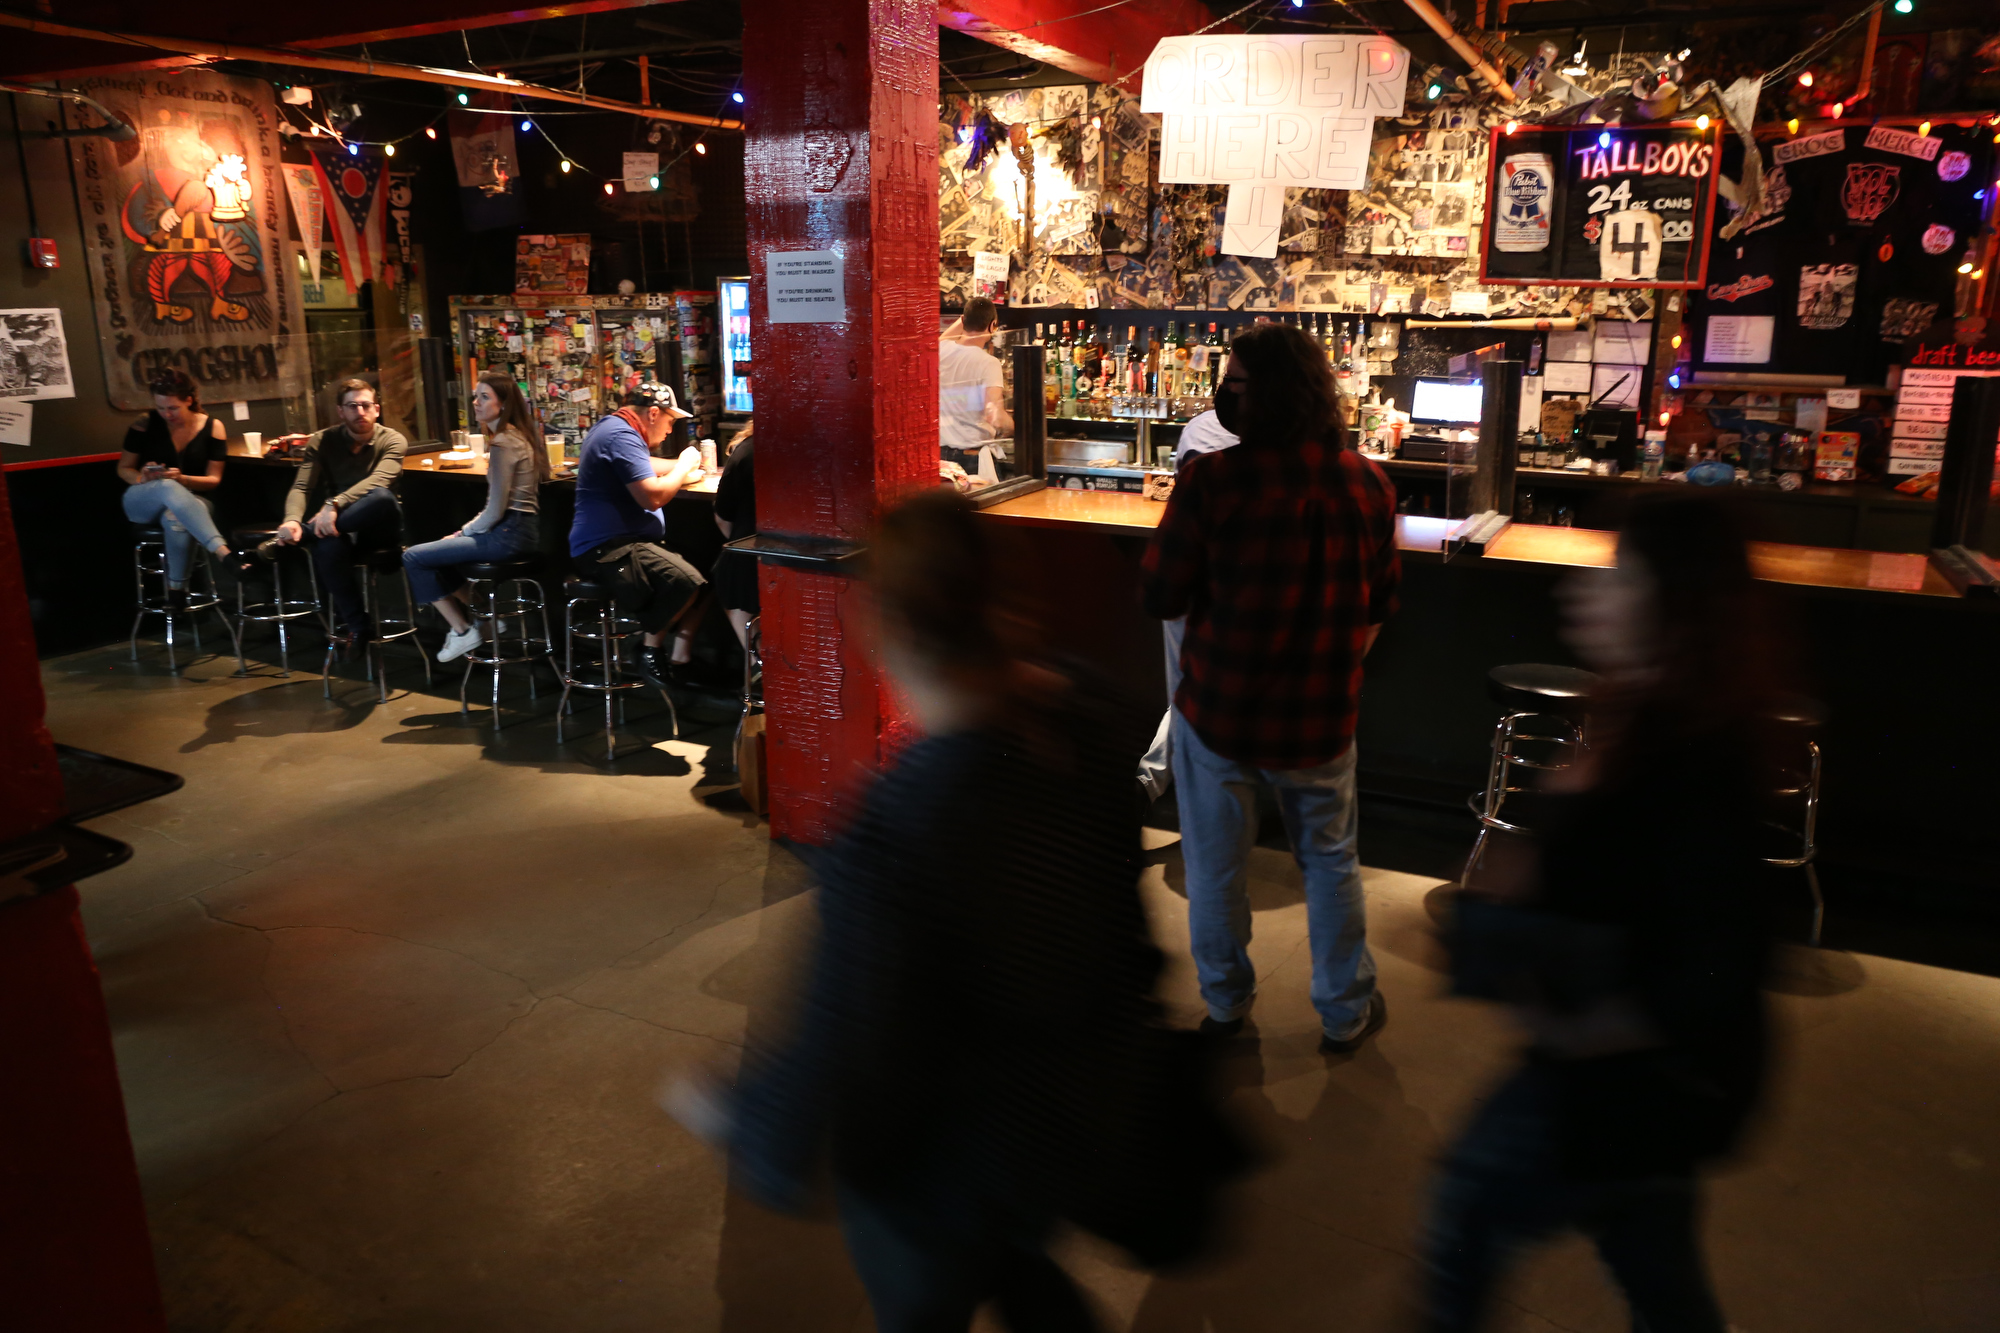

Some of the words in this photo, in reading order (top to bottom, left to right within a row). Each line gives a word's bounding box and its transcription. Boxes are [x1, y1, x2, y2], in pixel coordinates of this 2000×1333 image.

[1149, 39, 1406, 110] ORDER
[1163, 113, 1367, 181] HERE
[1777, 135, 1843, 162] GROG
[1867, 128, 1938, 158] MERCH
[1514, 173, 1538, 187] Pabst
[1587, 179, 1632, 214] 24
[1653, 196, 1693, 211] CANS
[1911, 343, 1957, 365] draft
